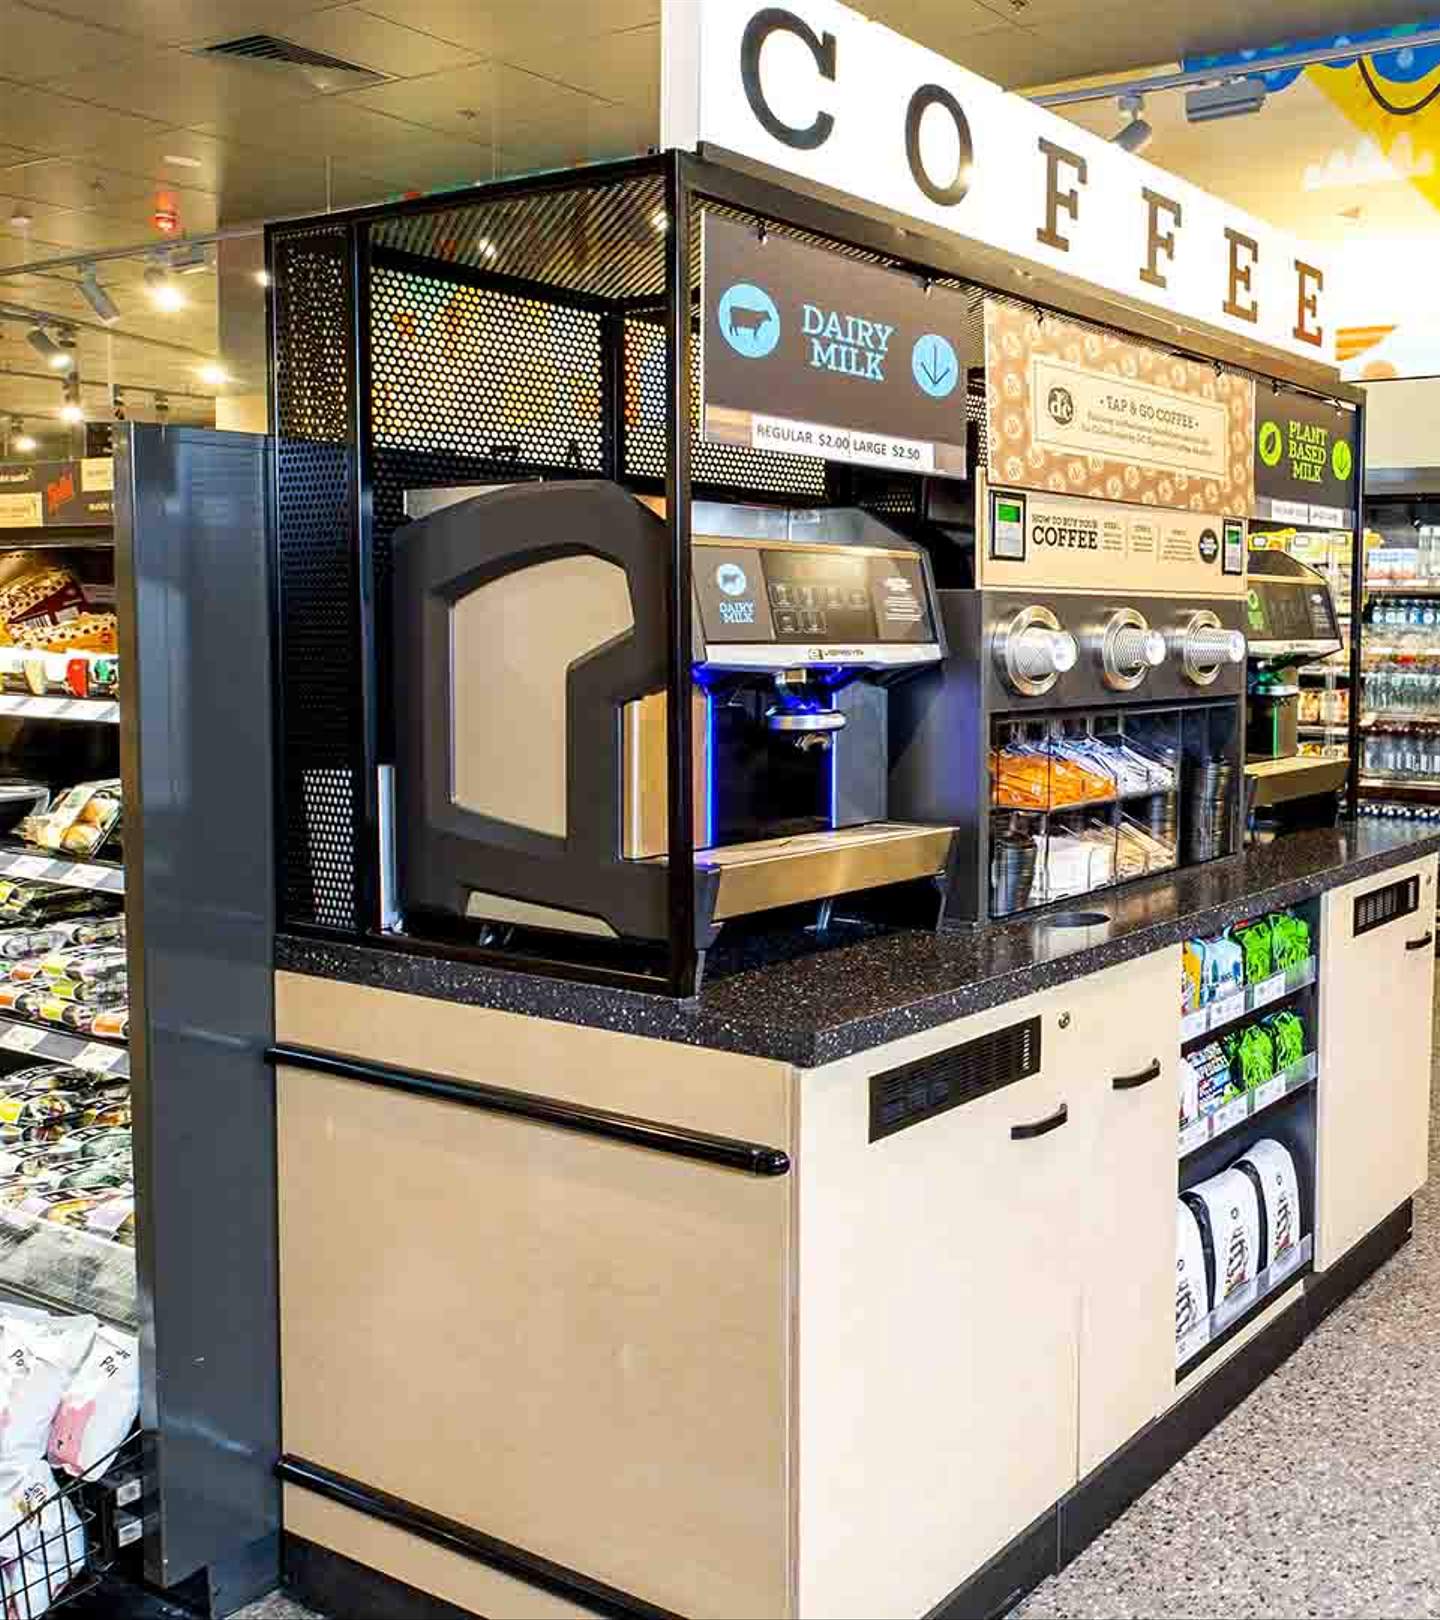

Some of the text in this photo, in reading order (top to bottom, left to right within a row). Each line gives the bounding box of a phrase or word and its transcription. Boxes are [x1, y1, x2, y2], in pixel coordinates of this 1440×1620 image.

[740, 6, 1324, 347] COFFEE
[802, 303, 895, 351] DAIRY
[810, 339, 886, 382] MILK
[1106, 395, 1128, 412] TAP
[1139, 403, 1154, 420] GO
[1156, 408, 1194, 430] COFFEE
[756, 423, 920, 461] REGULAR $2.00 LARGE $2.50
[1288, 420, 1329, 446] PLANT
[1288, 440, 1327, 464] BASED
[1293, 462, 1323, 483] MILK
[1031, 525, 1098, 550] COFFEE
[719, 601, 753, 614] DAIRY
[720, 611, 754, 624] MILK
